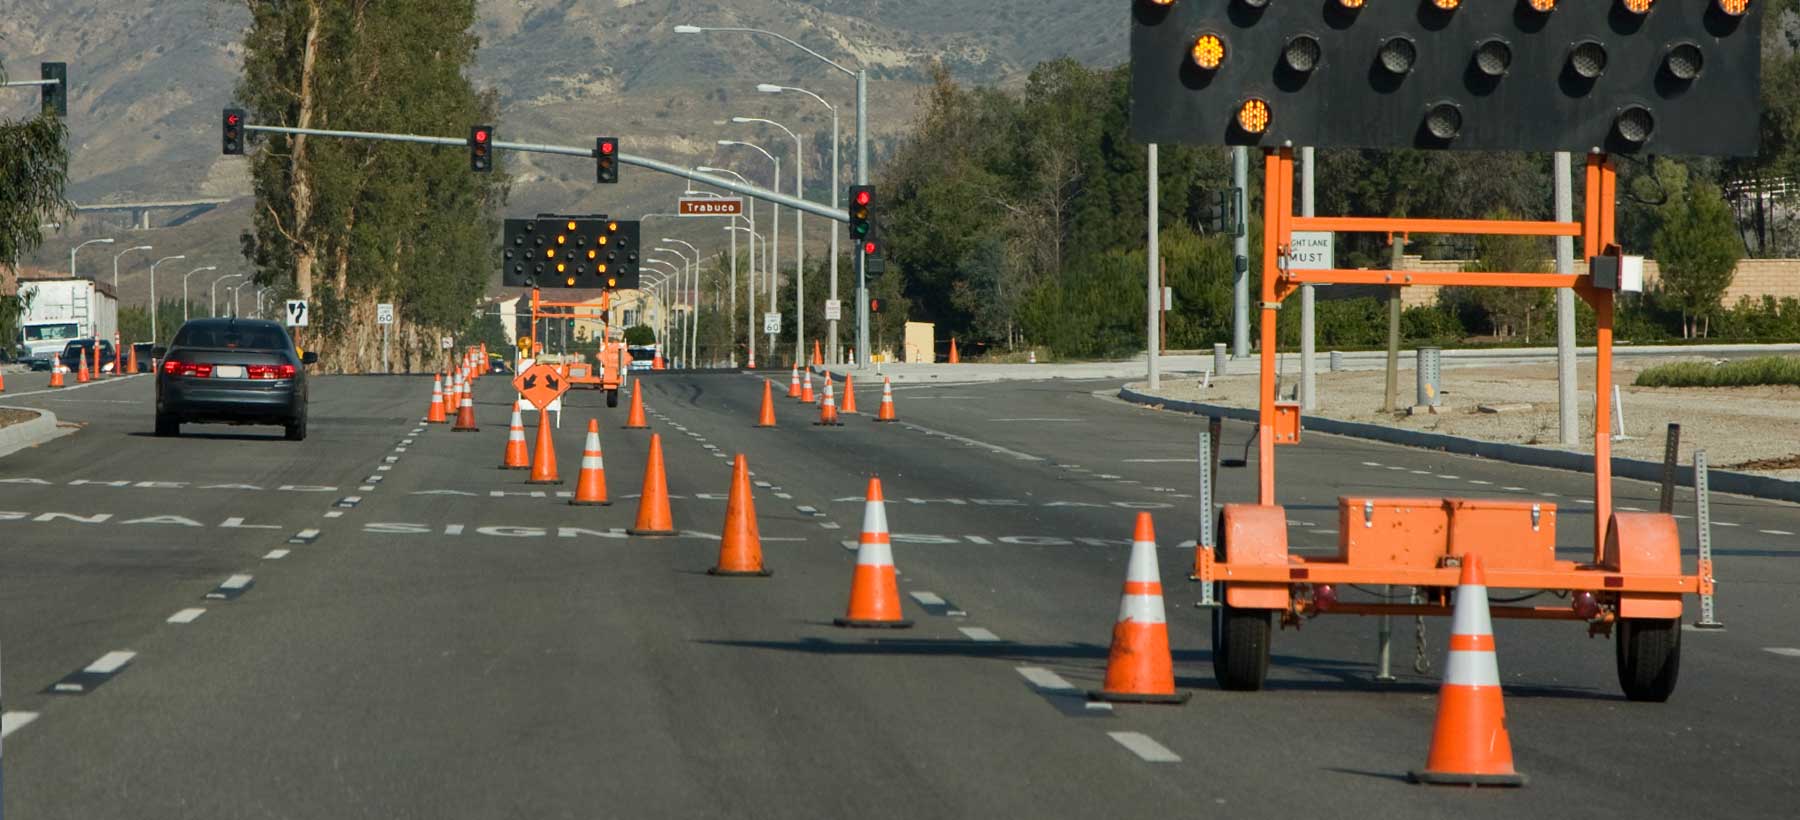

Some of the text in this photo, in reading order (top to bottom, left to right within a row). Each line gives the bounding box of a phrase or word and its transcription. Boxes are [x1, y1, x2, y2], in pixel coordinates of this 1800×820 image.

[687, 203, 735, 212] Trabuco
[1308, 239, 1328, 247] LANE
[1290, 253, 1323, 262] MUST
